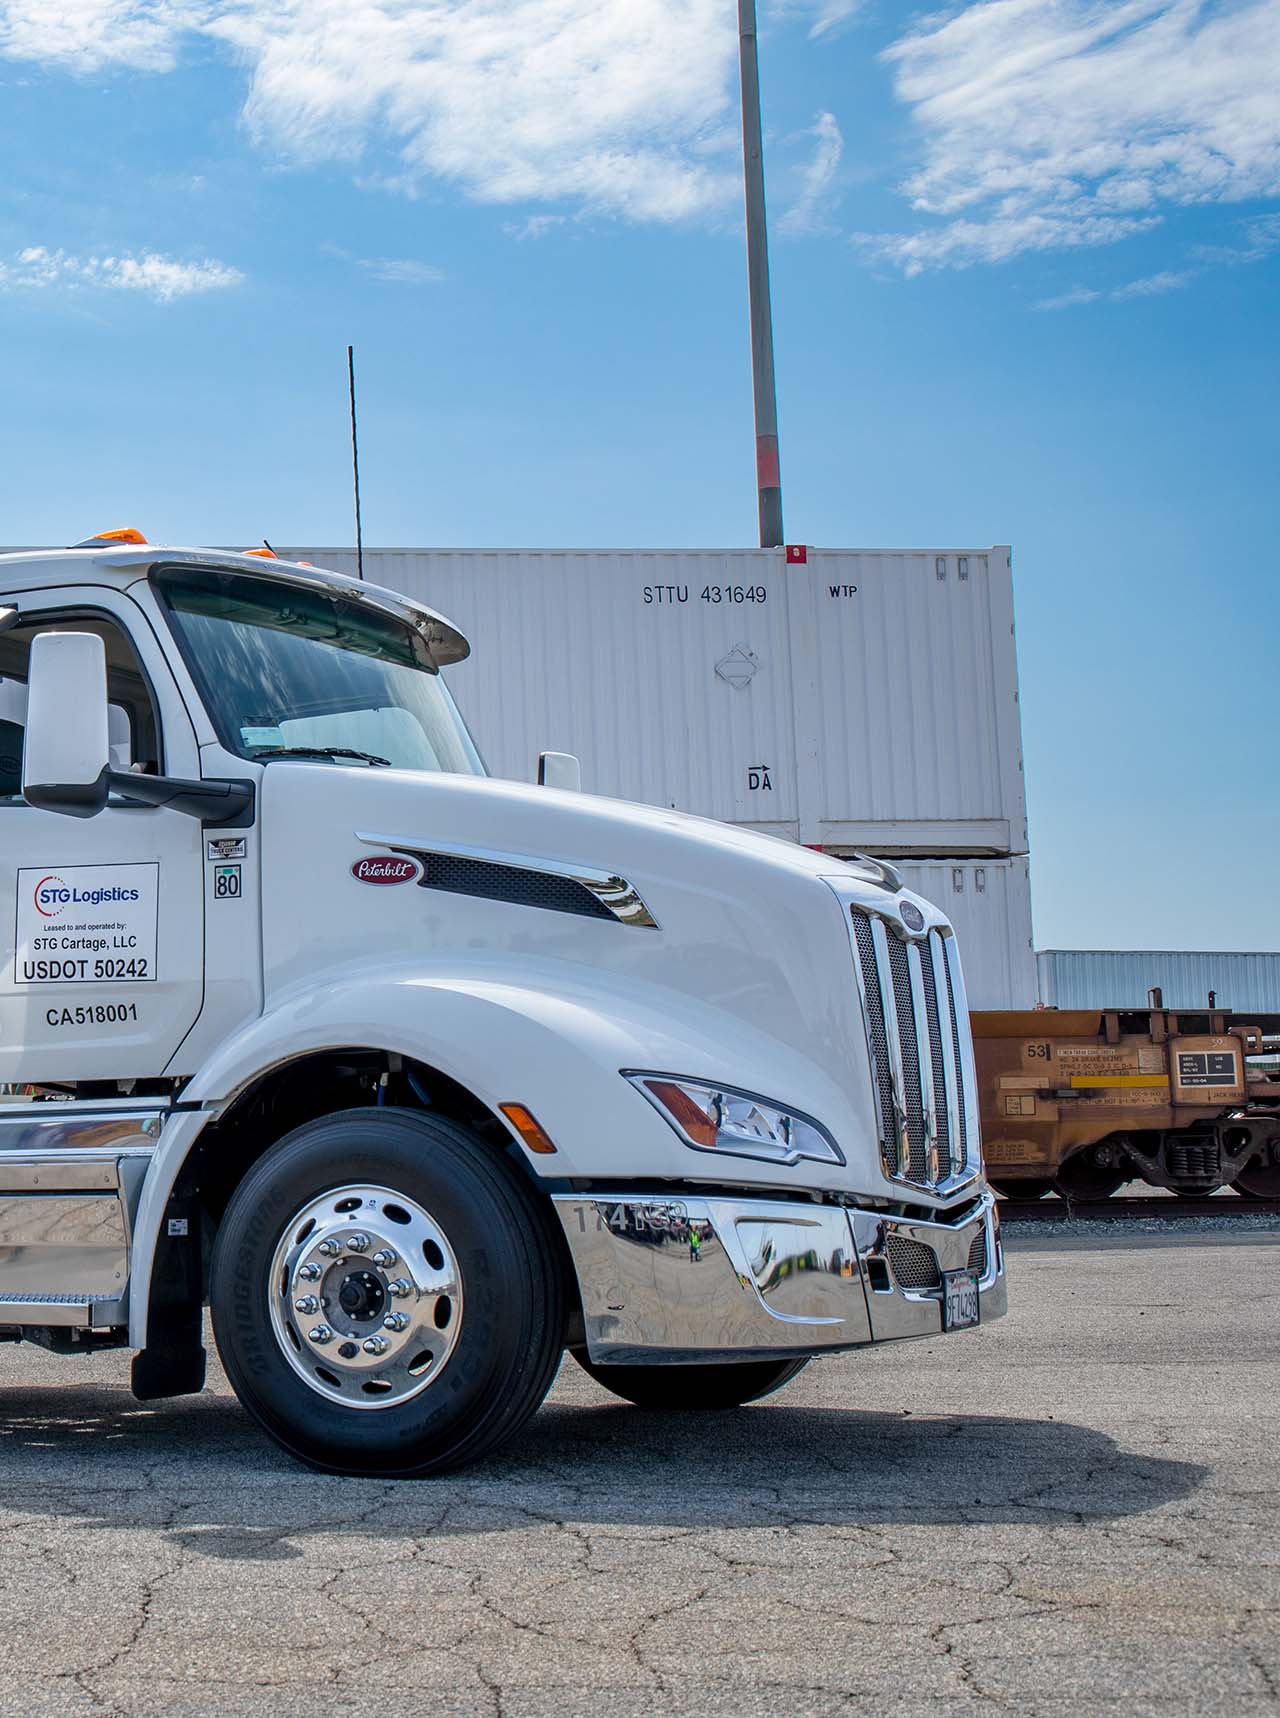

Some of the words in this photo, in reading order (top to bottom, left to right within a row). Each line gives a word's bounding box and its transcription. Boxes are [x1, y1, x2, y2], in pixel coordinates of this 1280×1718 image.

[643, 585, 689, 604] STTU
[700, 585, 767, 604] 431649
[828, 584, 858, 598] WTP
[748, 772, 773, 791] DA
[358, 860, 411, 878] Peterbilt
[217, 874, 239, 896] 80
[39, 888, 71, 904] STG
[72, 887, 140, 905] Logistics
[43, 924, 66, 932] Leased
[75, 923, 87, 931] and
[87, 922, 116, 932] operated
[33, 937, 58, 950] STG
[61, 936, 110, 952] Cartage,
[113, 935, 137, 948] LLC
[23, 960, 89, 980] USDOT
[93, 958, 148, 979] 50242
[1027, 1044, 1046, 1058] 53
